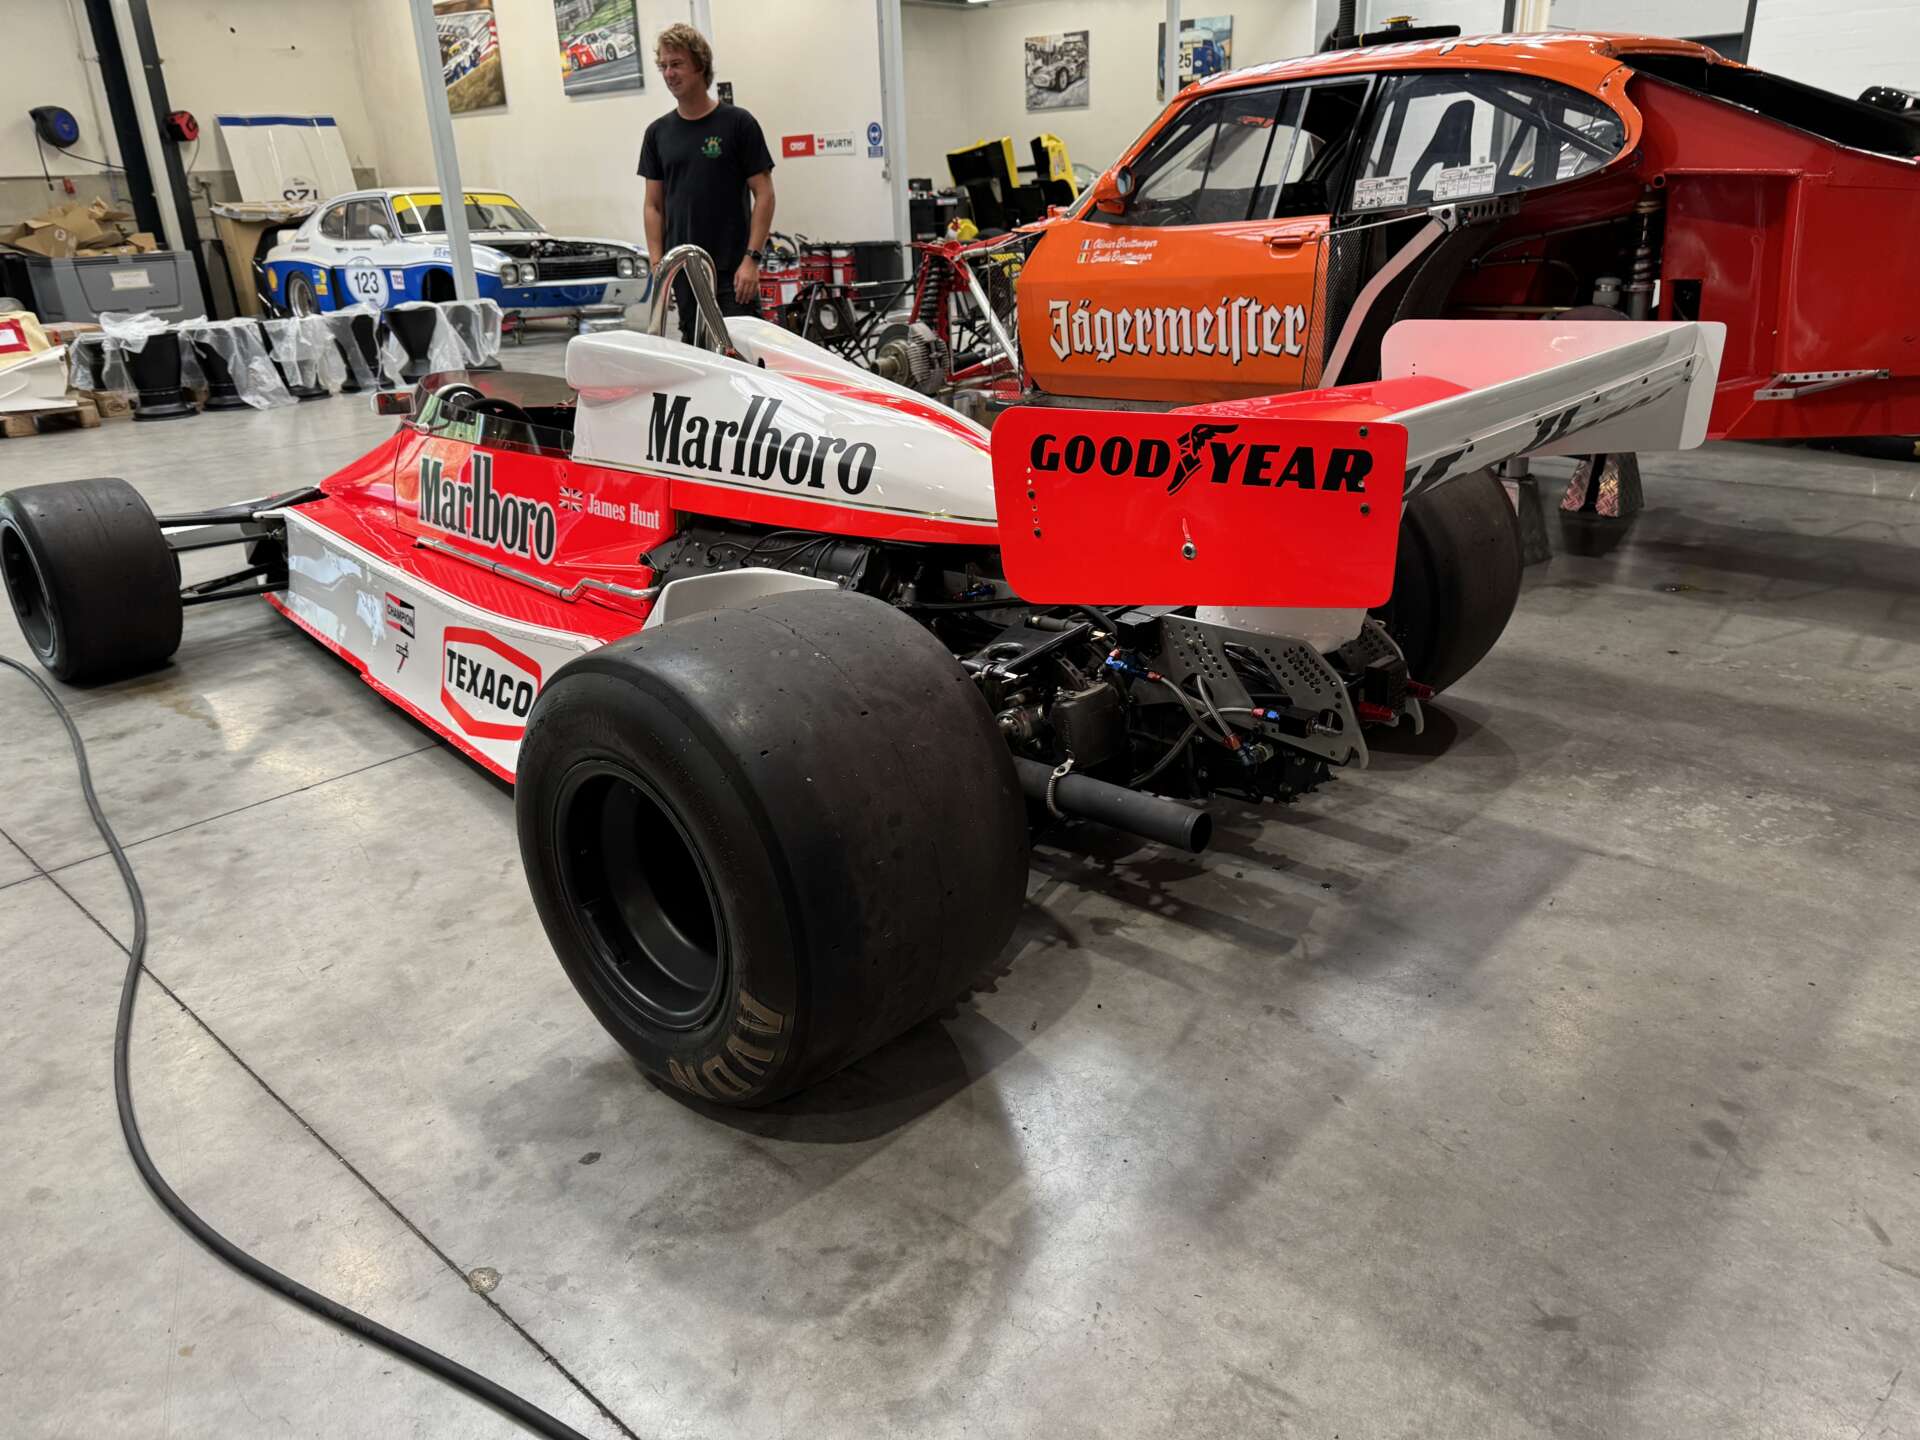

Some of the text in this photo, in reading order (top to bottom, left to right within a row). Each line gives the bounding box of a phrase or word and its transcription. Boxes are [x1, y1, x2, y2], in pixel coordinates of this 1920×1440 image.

[354, 271, 380, 294] 123
[1049, 297, 1305, 365] Jägermeister
[646, 392, 877, 495] Marlboro
[1030, 434, 1171, 478] GOOD
[1211, 443, 1374, 493] YEAR
[419, 452, 556, 562] Marlboro
[588, 493, 660, 530] James Hunt
[387, 604, 414, 627] CHAMPION
[446, 648, 533, 718] TEXACO
[665, 990, 784, 1099] AVON
